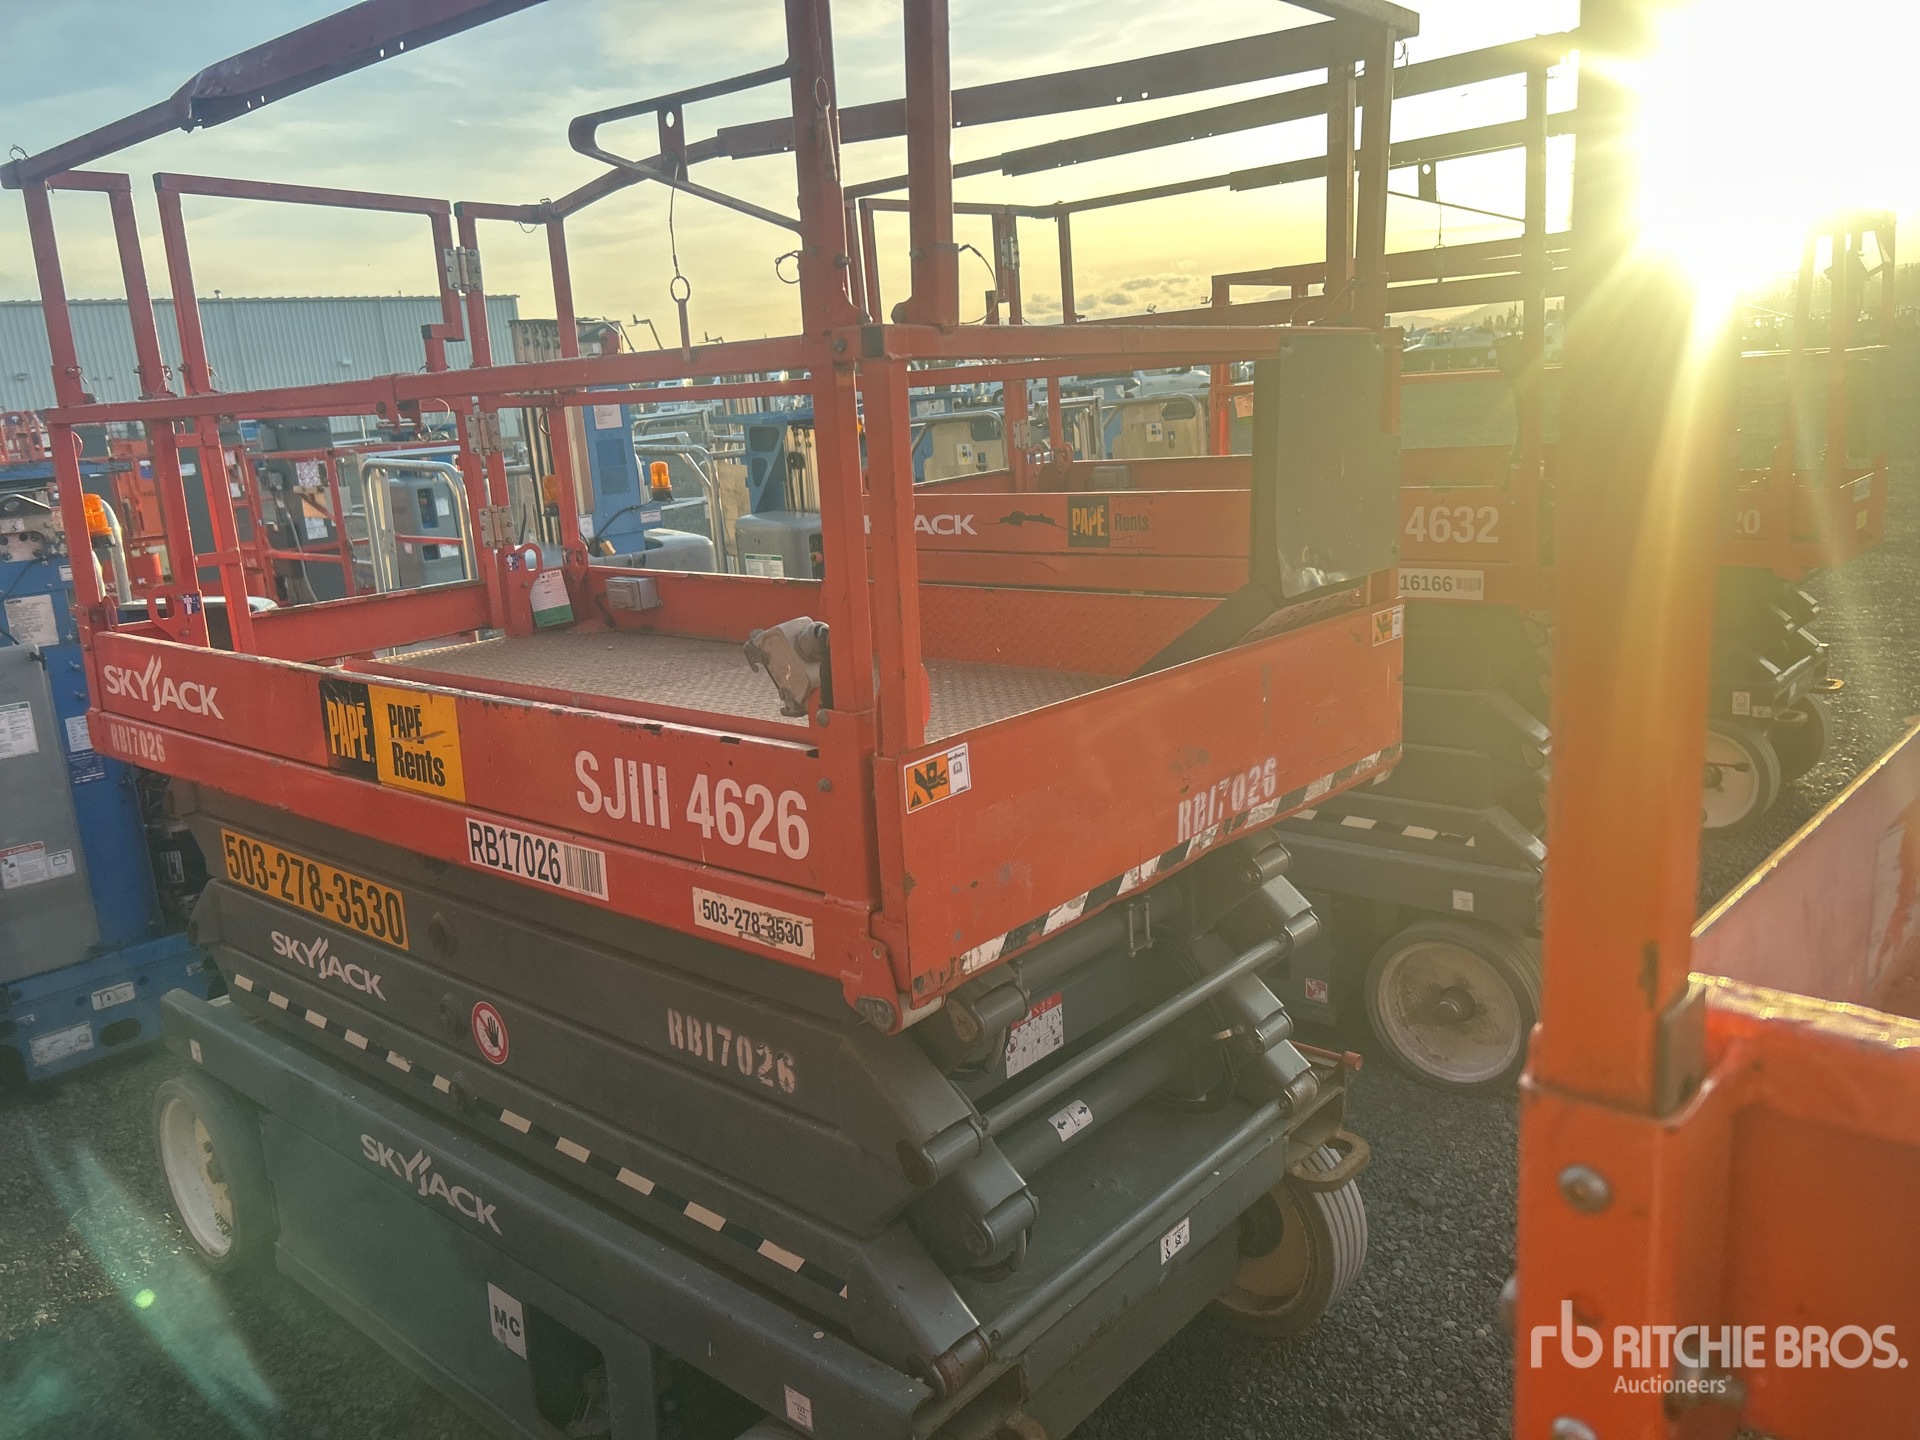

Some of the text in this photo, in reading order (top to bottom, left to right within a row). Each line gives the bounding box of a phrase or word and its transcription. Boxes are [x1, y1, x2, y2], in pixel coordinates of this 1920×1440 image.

[913, 514, 978, 535] ACK
[1114, 512, 1149, 532] Rents
[1404, 506, 1499, 543] 4632
[1400, 575, 1453, 592] 16166
[103, 654, 225, 720] SKYJACK
[110, 723, 165, 762] RB17026
[391, 742, 446, 787] Rents
[685, 773, 811, 861] 4626
[1178, 757, 1276, 844] RB17026
[468, 820, 562, 886] RB17026
[226, 834, 405, 947] 503-278-3530
[702, 898, 804, 948] 503-278-3530
[271, 930, 386, 1001] SKYJACK
[667, 1008, 797, 1095] RB17026
[360, 1133, 503, 1236] SKYJACK
[493, 1305, 521, 1338] MC
